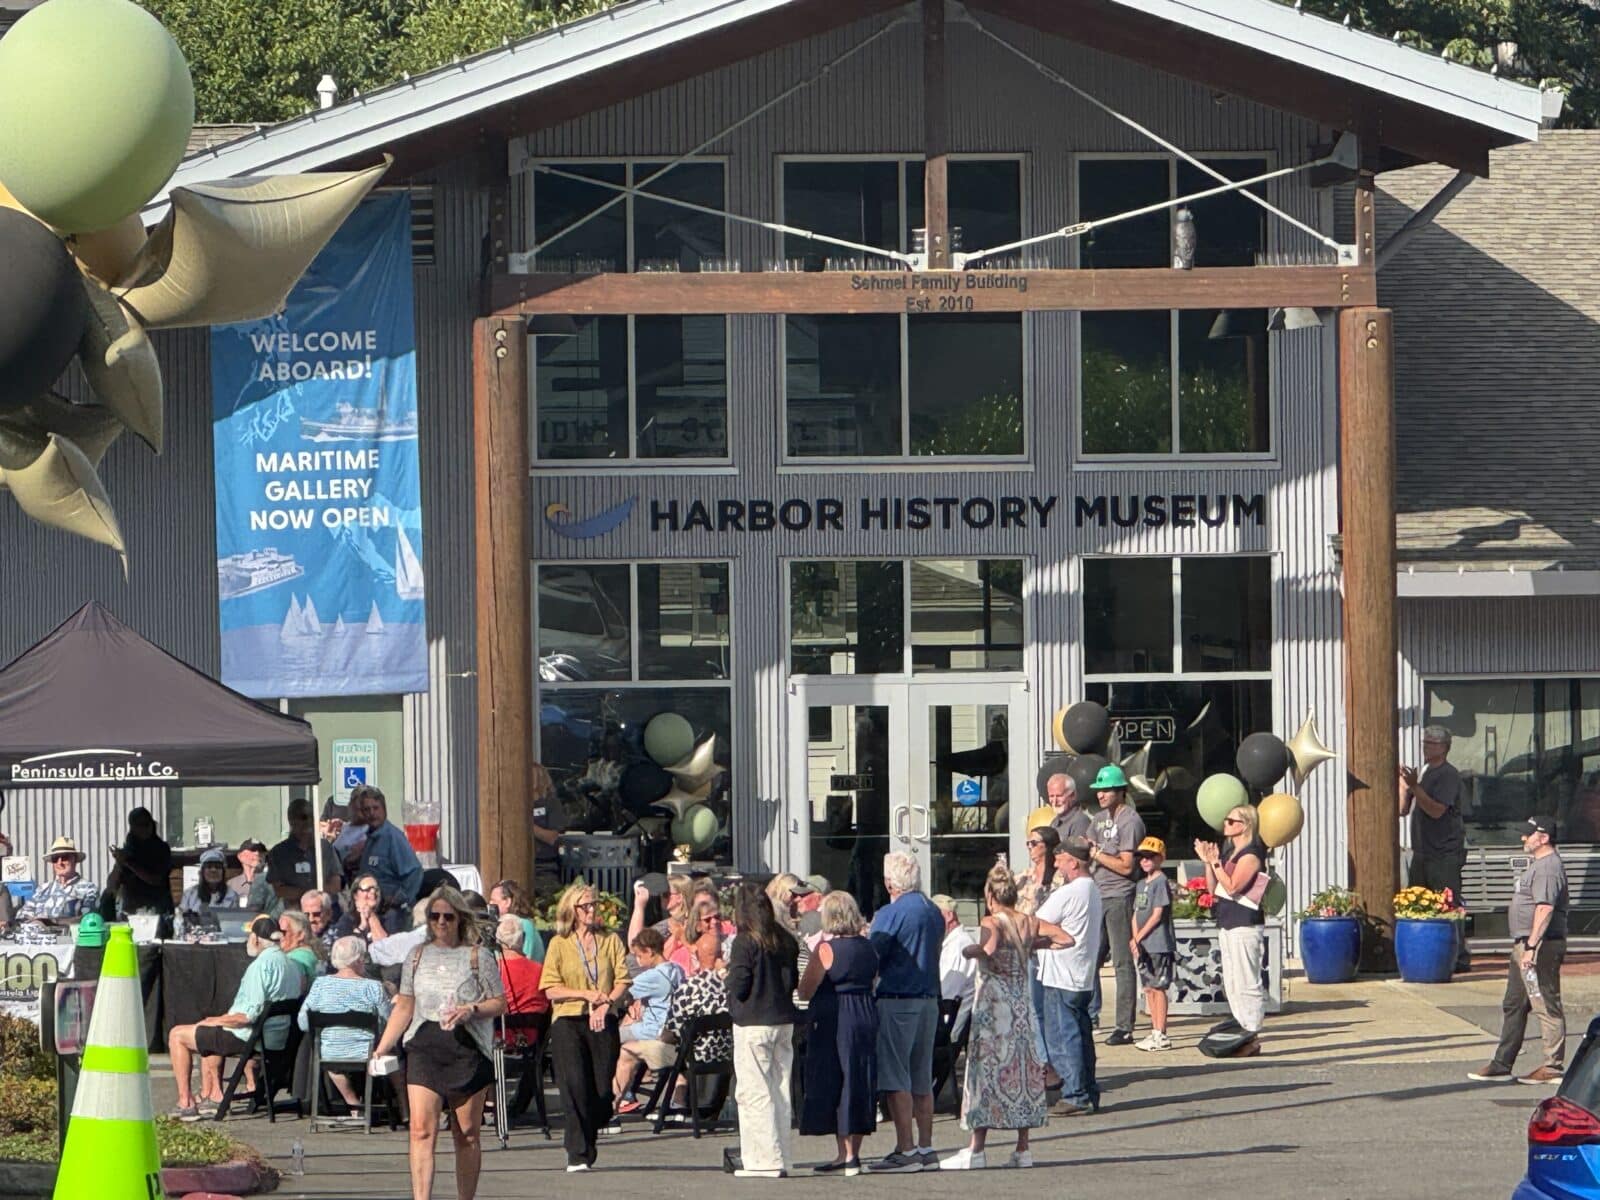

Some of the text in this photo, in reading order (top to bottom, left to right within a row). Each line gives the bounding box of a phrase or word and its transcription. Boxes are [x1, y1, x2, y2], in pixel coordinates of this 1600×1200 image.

[911, 274, 961, 292] Family
[965, 274, 1028, 292] Building
[938, 295, 974, 311] 2010
[250, 330, 377, 353] WELCOME
[258, 354, 372, 381] ABOARD!
[255, 449, 380, 472] MARITIME
[265, 478, 372, 501] GALLERY
[250, 506, 391, 530] NOW OPEN
[650, 494, 1265, 531] HARBOR HISTORY MUSEUM
[11, 761, 179, 781] Peninsula Light Co.
